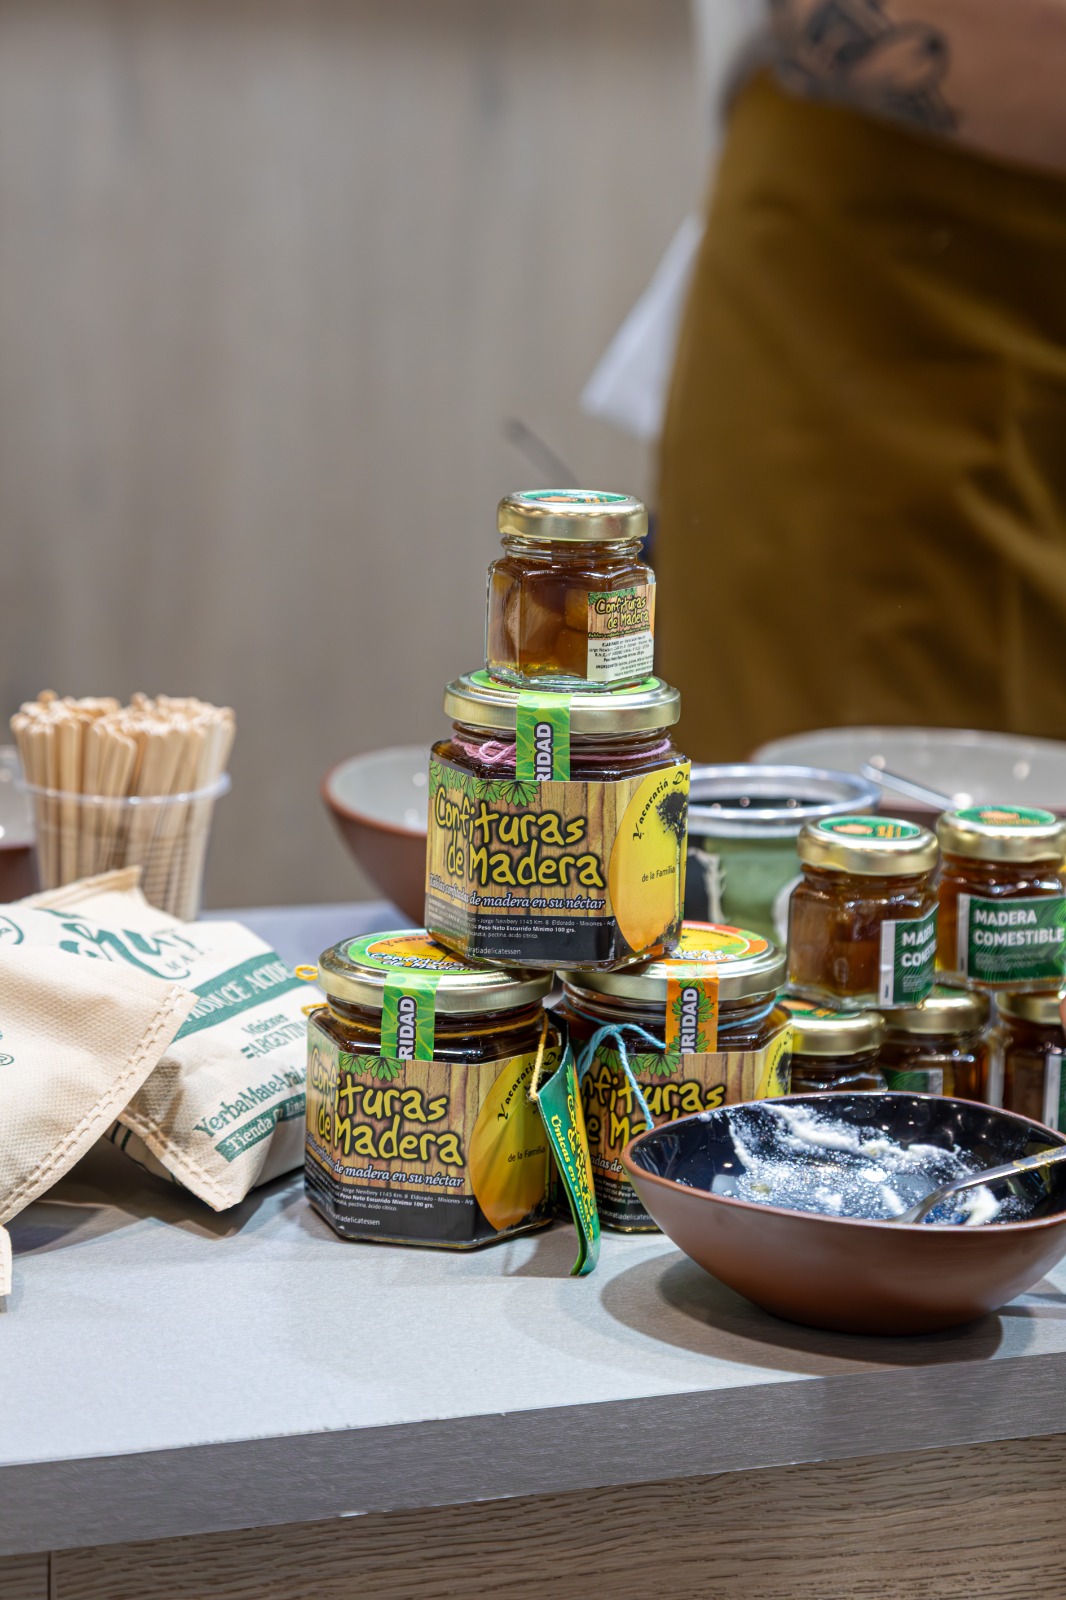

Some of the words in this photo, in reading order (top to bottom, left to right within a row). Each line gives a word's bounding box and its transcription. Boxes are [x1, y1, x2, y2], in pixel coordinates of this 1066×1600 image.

[595, 597, 646, 614] Confituras
[607, 616, 618, 630] de
[620, 610, 649, 627] Madera
[435, 787, 587, 846] Confituras
[447, 829, 465, 876] de
[469, 839, 606, 888] Madera
[642, 873, 649, 883] de
[656, 865, 676, 878] Familia
[470, 890, 480, 906] de
[483, 892, 530, 908] madera
[531, 896, 547, 908] en
[549, 897, 564, 908] su
[566, 894, 606, 909] néctar
[974, 909, 1038, 927] MADERA
[974, 927, 1065, 947] COMESTIBLE
[311, 1048, 448, 1123] Confituras
[227, 1117, 273, 1151] Tienda
[318, 1094, 331, 1141] de
[334, 1114, 465, 1167] Madera
[508, 1152, 516, 1162] de
[524, 1145, 546, 1157] Familia
[551, 1114, 571, 1164] Únicas
[568, 1162, 577, 1184] en
[334, 1160, 344, 1174] de
[345, 1164, 390, 1180] madera
[392, 1170, 407, 1182] en
[408, 1172, 422, 1183] su
[424, 1171, 465, 1187] néctar
[610, 1158, 623, 1173] de
[340, 1192, 352, 1200] Peso
[366, 1195, 391, 1204] Escurrido
[342, 1186, 355, 1194] Jorge
[355, 1188, 378, 1197] Newbery
[410, 1194, 434, 1202] Eldorado
[437, 1196, 461, 1204] Misiones
